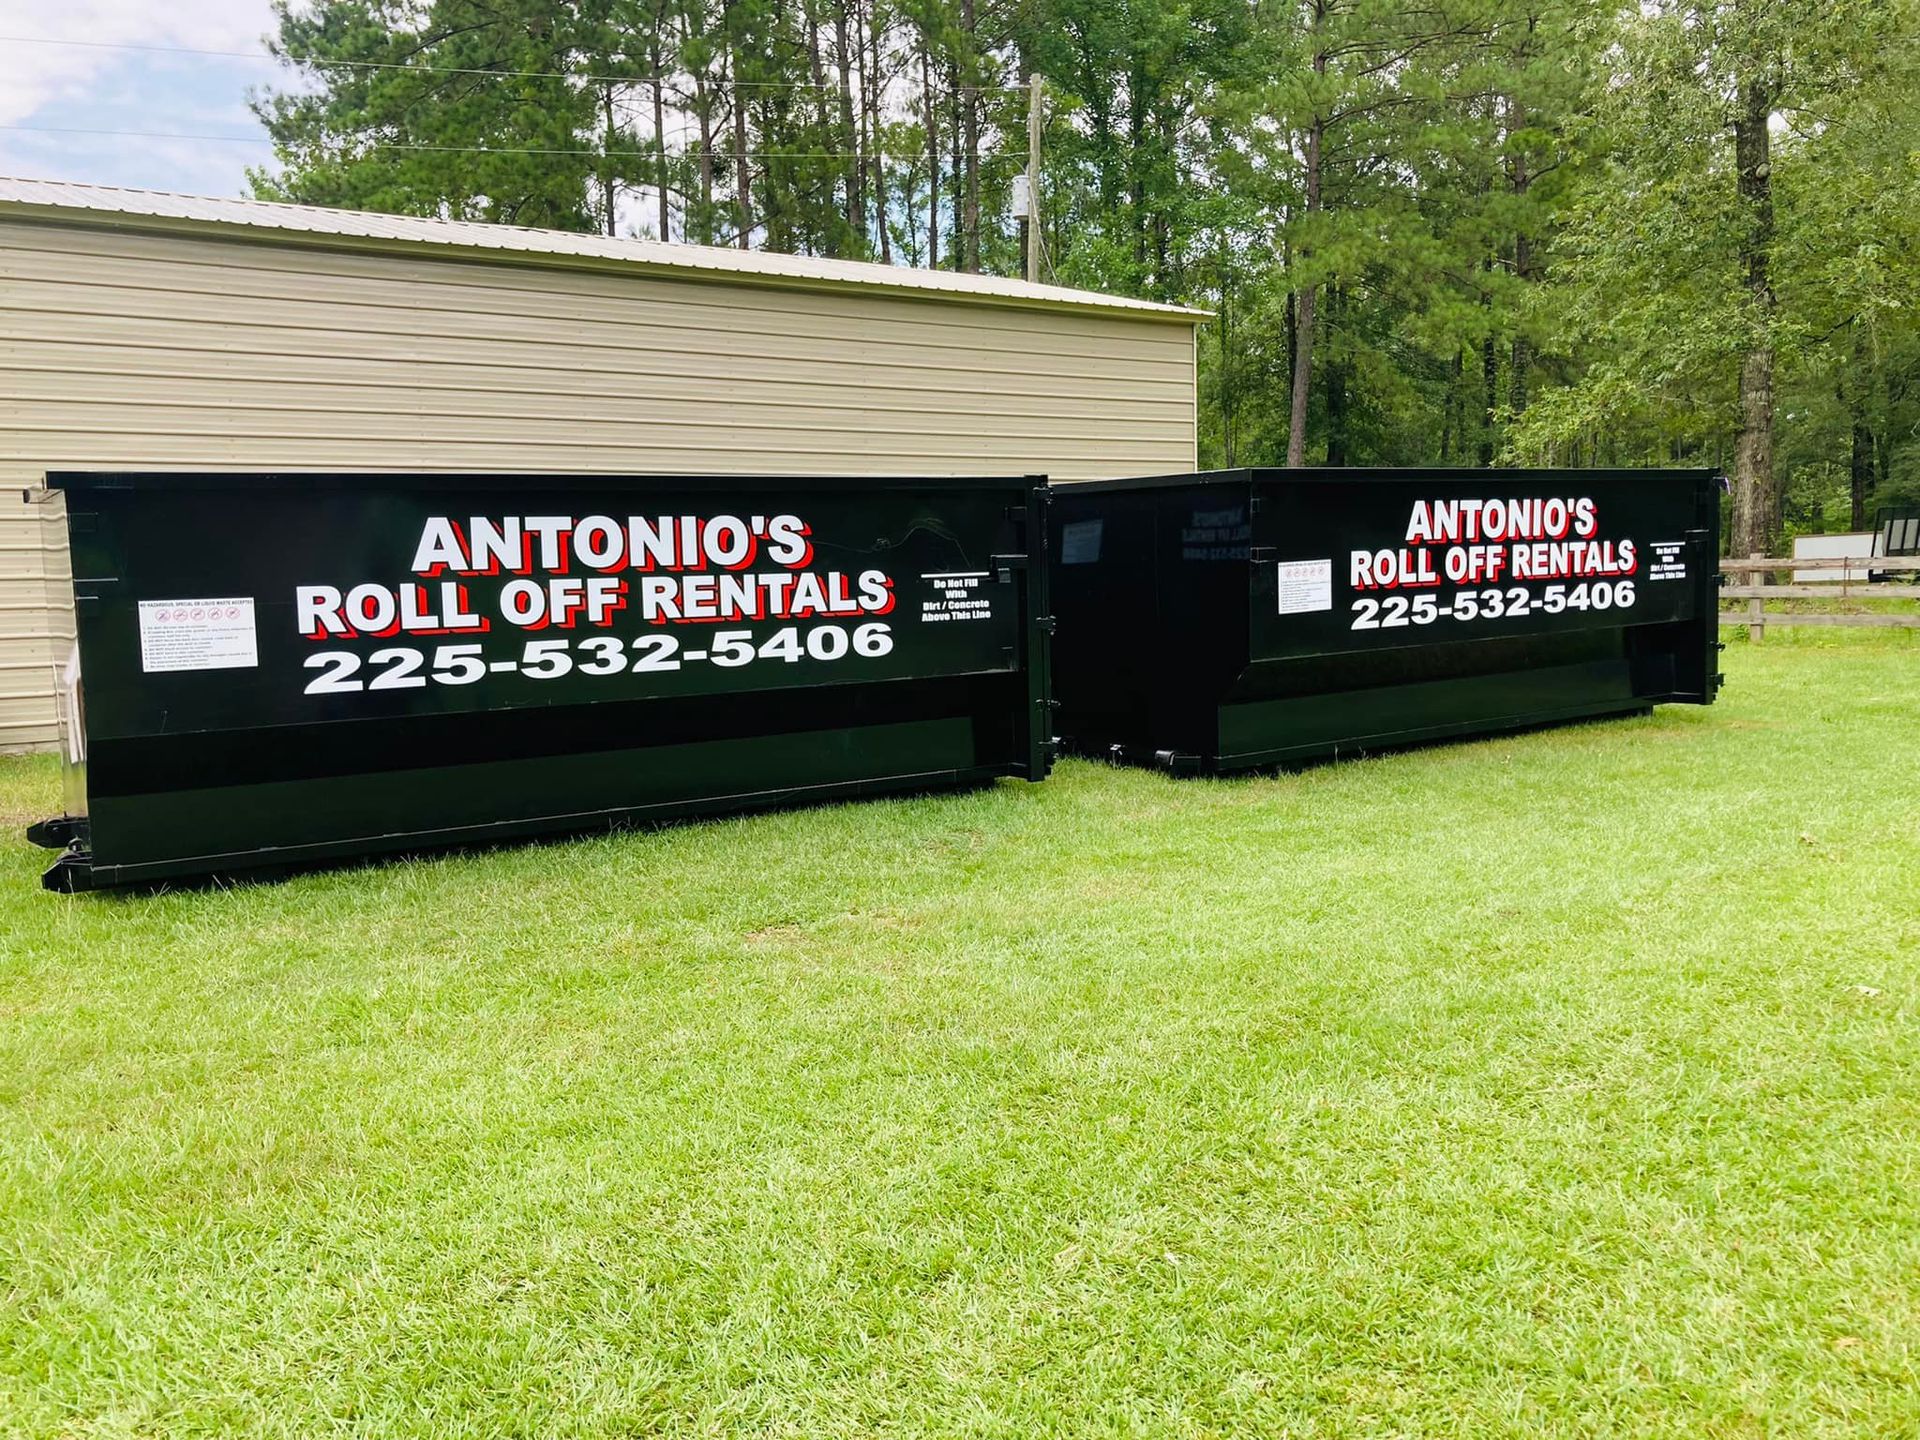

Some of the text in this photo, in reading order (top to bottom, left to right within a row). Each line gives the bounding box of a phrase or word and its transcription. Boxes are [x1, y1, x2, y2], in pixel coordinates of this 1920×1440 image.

[410, 514, 813, 576] ANTONIO'S
[1405, 497, 1597, 544] ANTONIO'S
[933, 578, 979, 588] Do Not Fill
[1350, 539, 1637, 590] ROLL OFF RENTALS
[296, 569, 896, 640] ROLL OFF RENTALS
[921, 609, 991, 622] Above This Line
[922, 601, 941, 611] Dirt
[947, 599, 990, 610] Concrete
[945, 589, 968, 599] With
[1350, 580, 1636, 631] 225-532-5406
[303, 622, 894, 695] 225-532-5406
